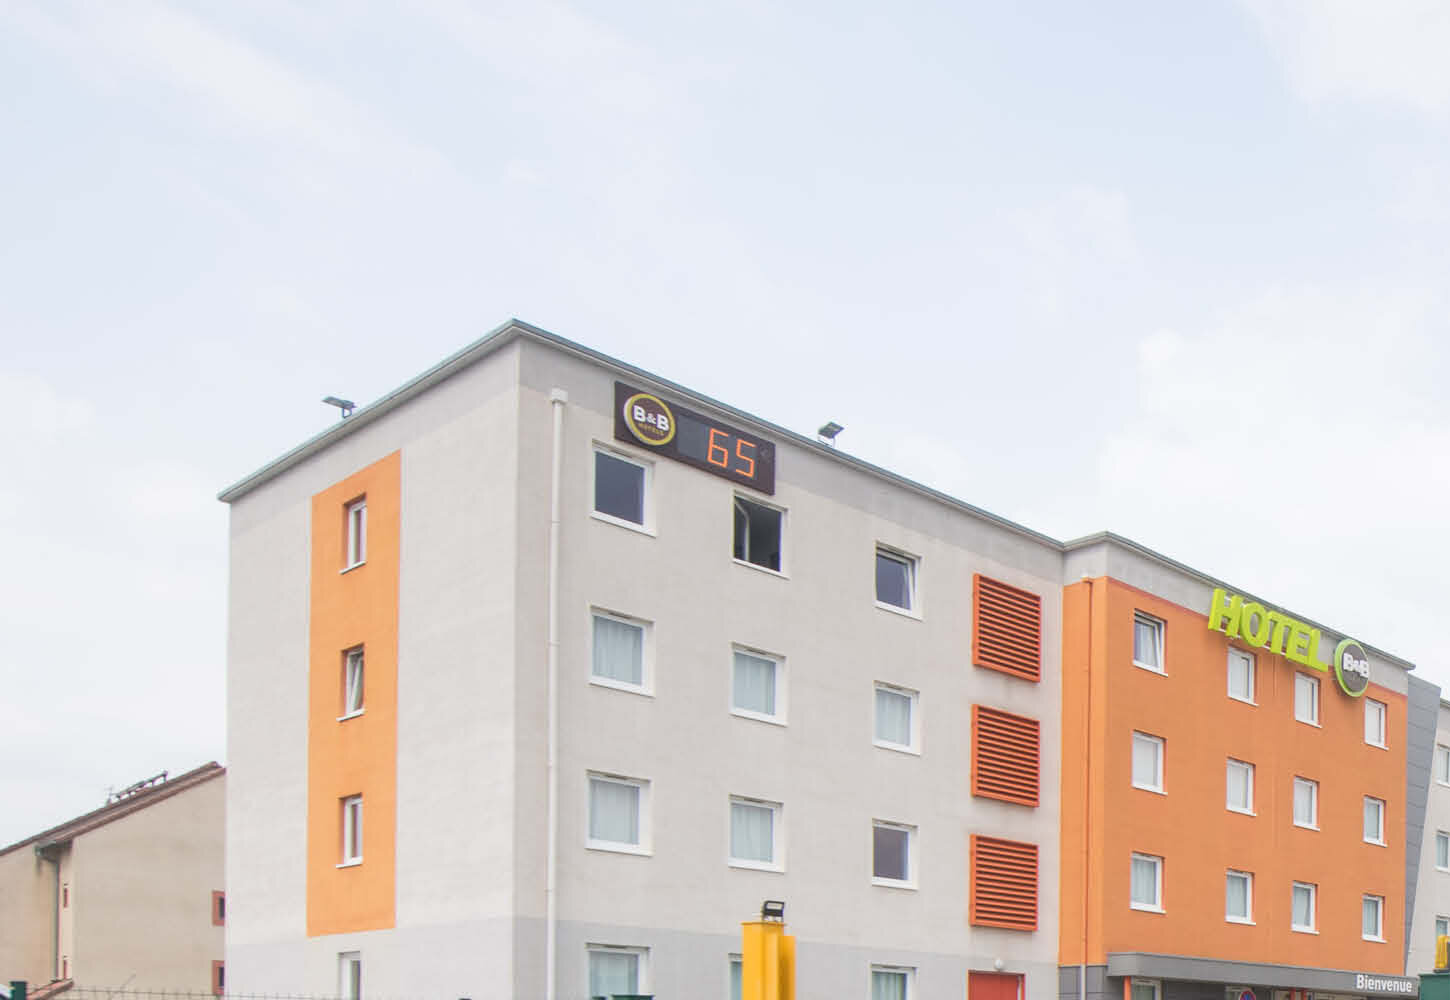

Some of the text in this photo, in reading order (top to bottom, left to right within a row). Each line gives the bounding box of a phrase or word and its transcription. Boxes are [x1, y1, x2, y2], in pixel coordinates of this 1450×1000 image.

[634, 405, 669, 431] B&B
[707, 428, 756, 477] 65
[1208, 588, 1328, 672] HOTEL
[1356, 974, 1412, 992] Bienvenue
